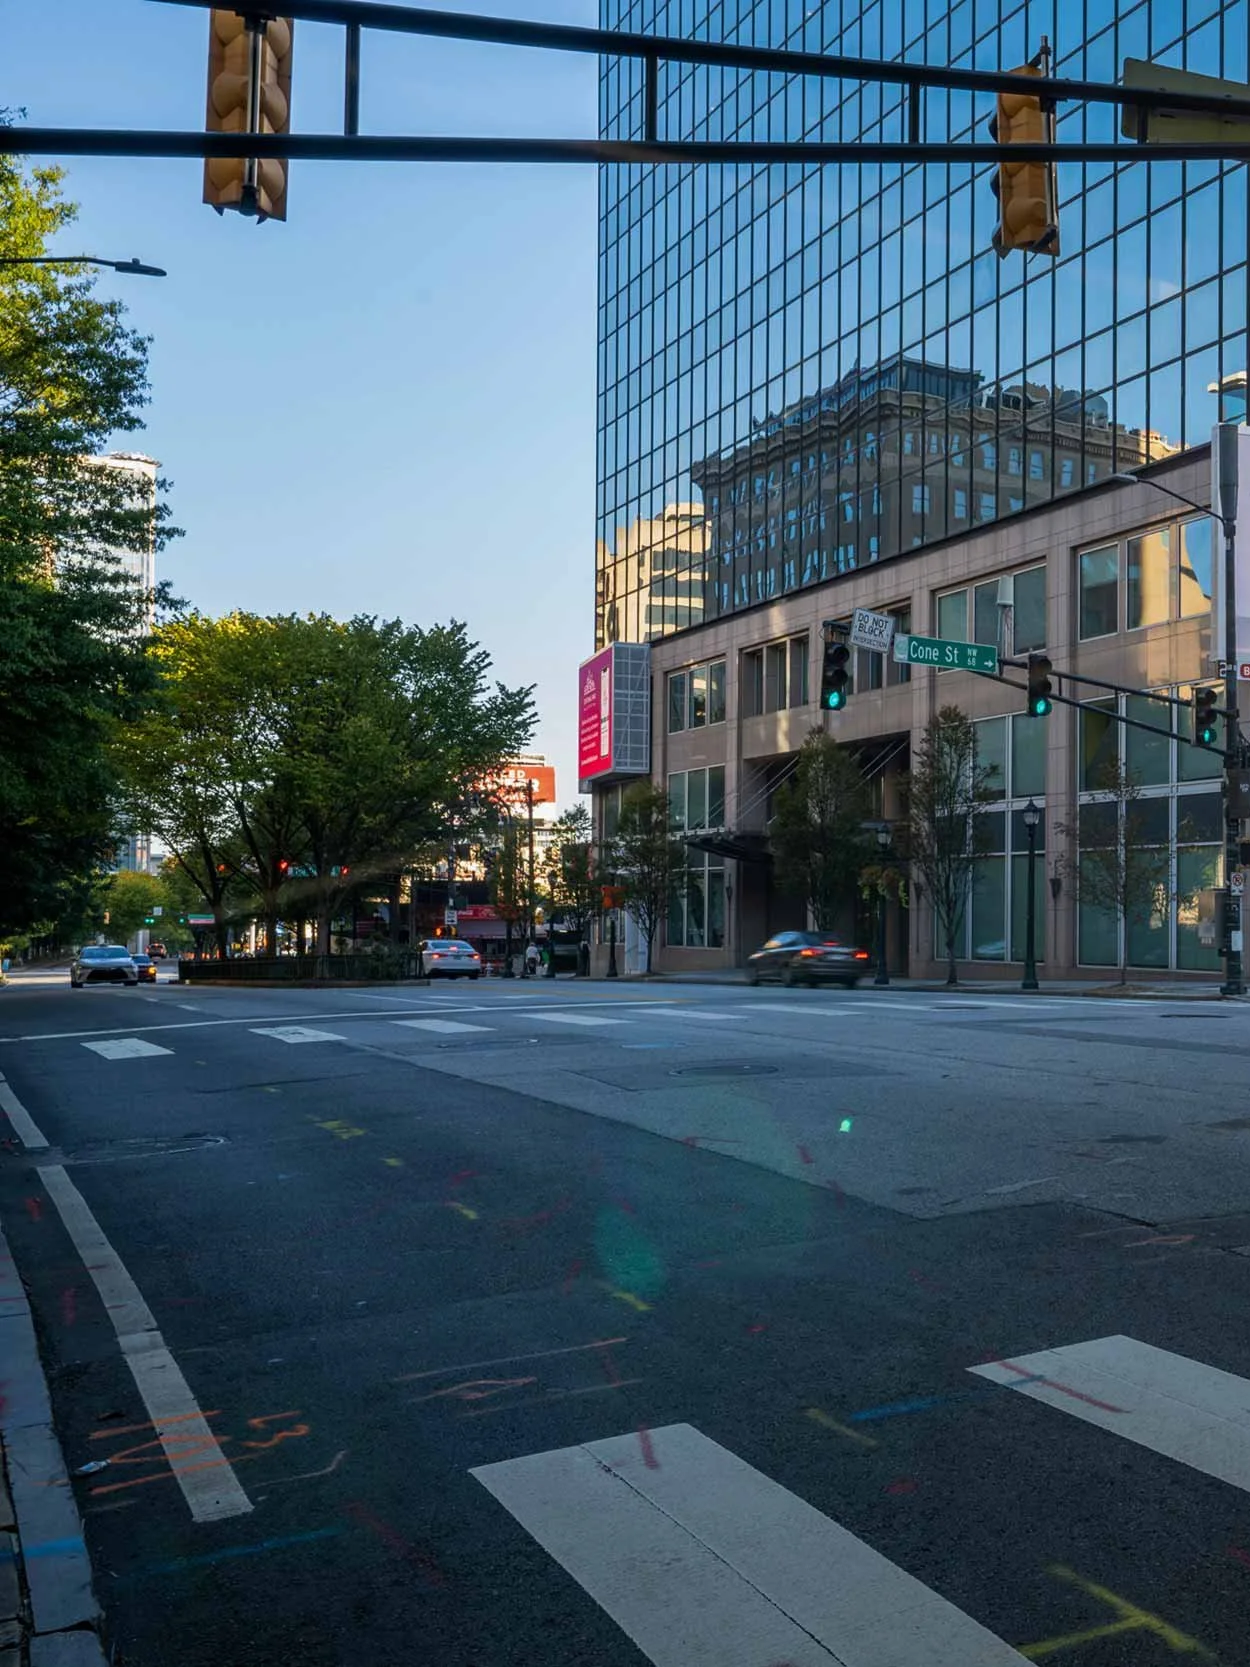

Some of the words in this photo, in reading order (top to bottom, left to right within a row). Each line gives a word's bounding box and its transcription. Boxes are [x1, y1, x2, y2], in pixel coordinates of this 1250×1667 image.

[857, 613, 869, 624] DO
[872, 617, 889, 629] NOT
[858, 622, 885, 638] BLOCK
[910, 640, 939, 661] Cone
[945, 645, 959, 664] St
[967, 647, 978, 657] NW
